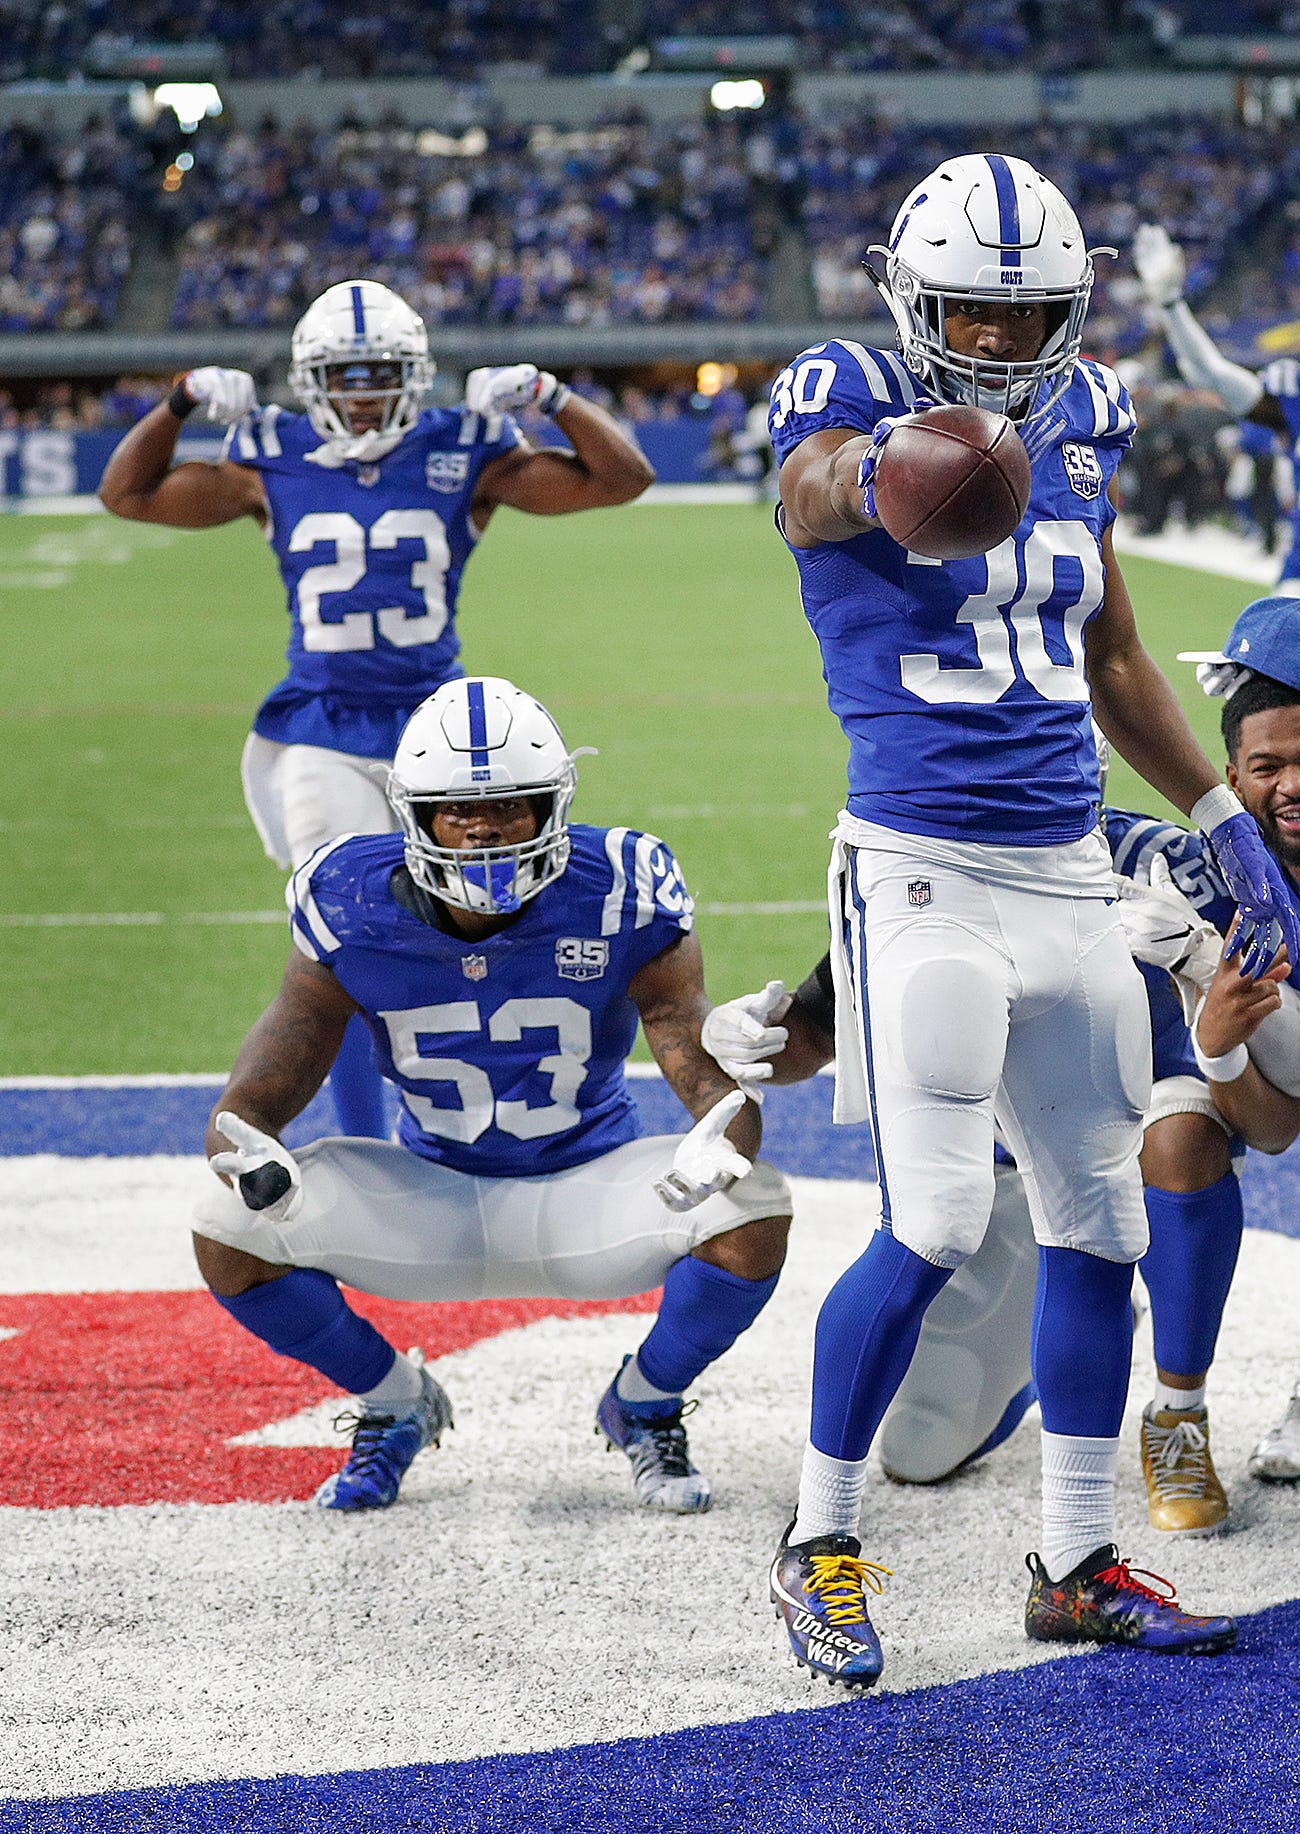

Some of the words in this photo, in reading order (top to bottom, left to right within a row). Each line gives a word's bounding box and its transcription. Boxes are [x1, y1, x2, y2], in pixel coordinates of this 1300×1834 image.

[1000, 271, 1023, 285] COLTS
[770, 357, 837, 429] 30
[1064, 444, 1098, 480] 35
[288, 511, 451, 653] 23
[900, 519, 1105, 704] 30
[558, 939, 607, 965] 35
[376, 997, 592, 1145] 53
[792, 1610, 869, 1656] United
[806, 1638, 852, 1674] Way
